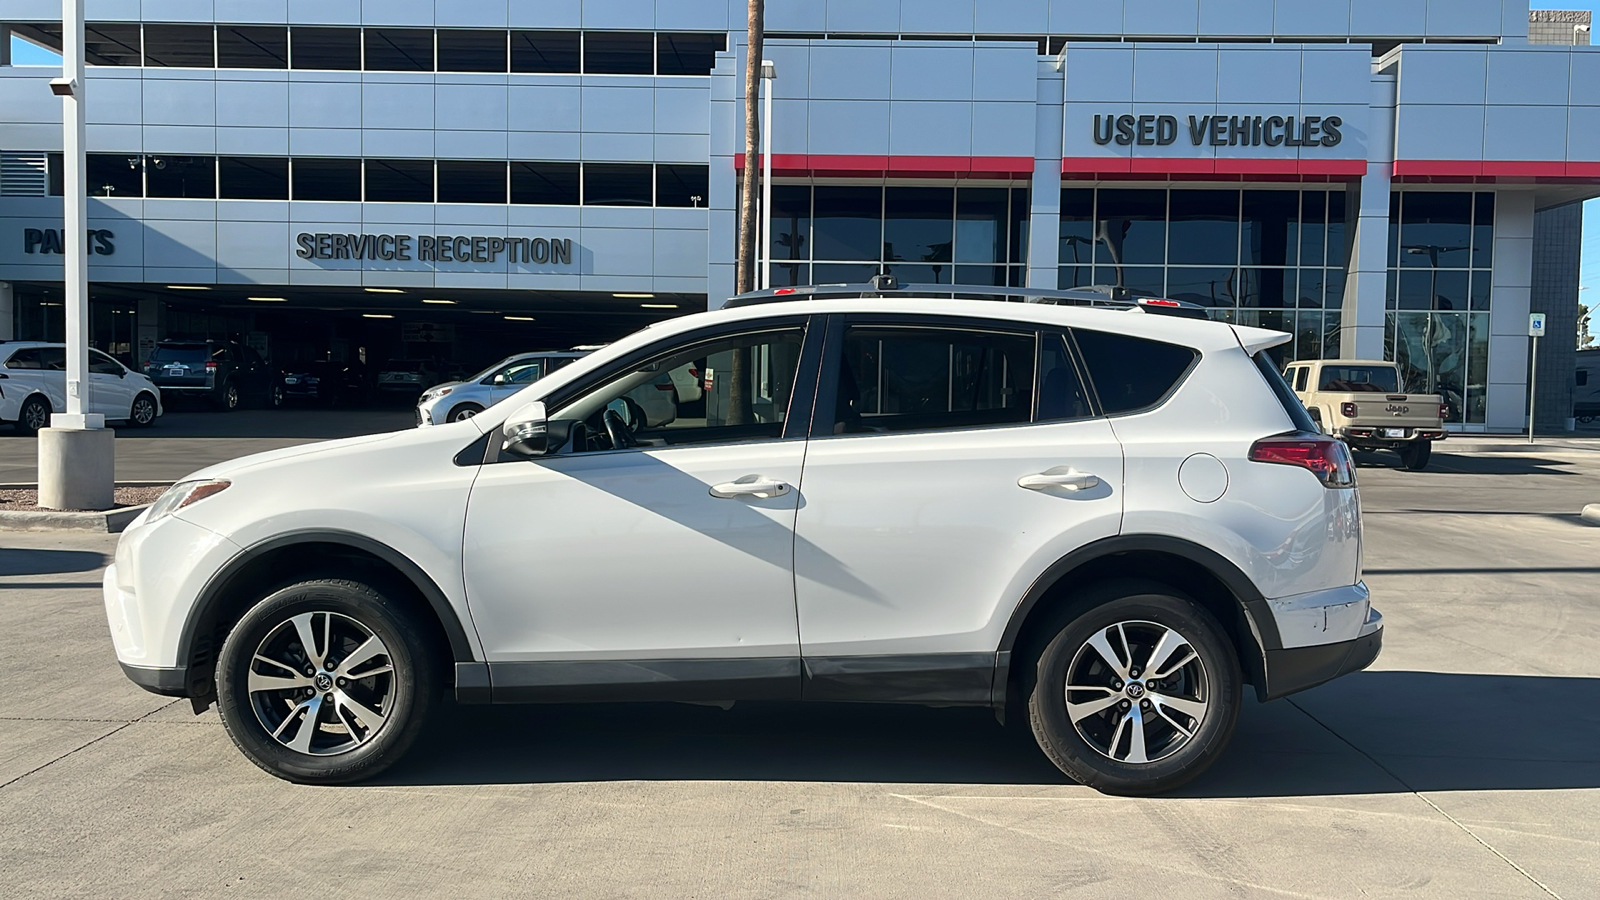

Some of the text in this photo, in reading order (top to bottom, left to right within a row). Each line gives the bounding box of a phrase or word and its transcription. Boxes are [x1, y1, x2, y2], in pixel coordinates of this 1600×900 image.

[1093, 114, 1342, 147] USED VEHICLES
[296, 233, 571, 264] SERVICE RECEPTION
[1385, 403, 1410, 414] Jeep
